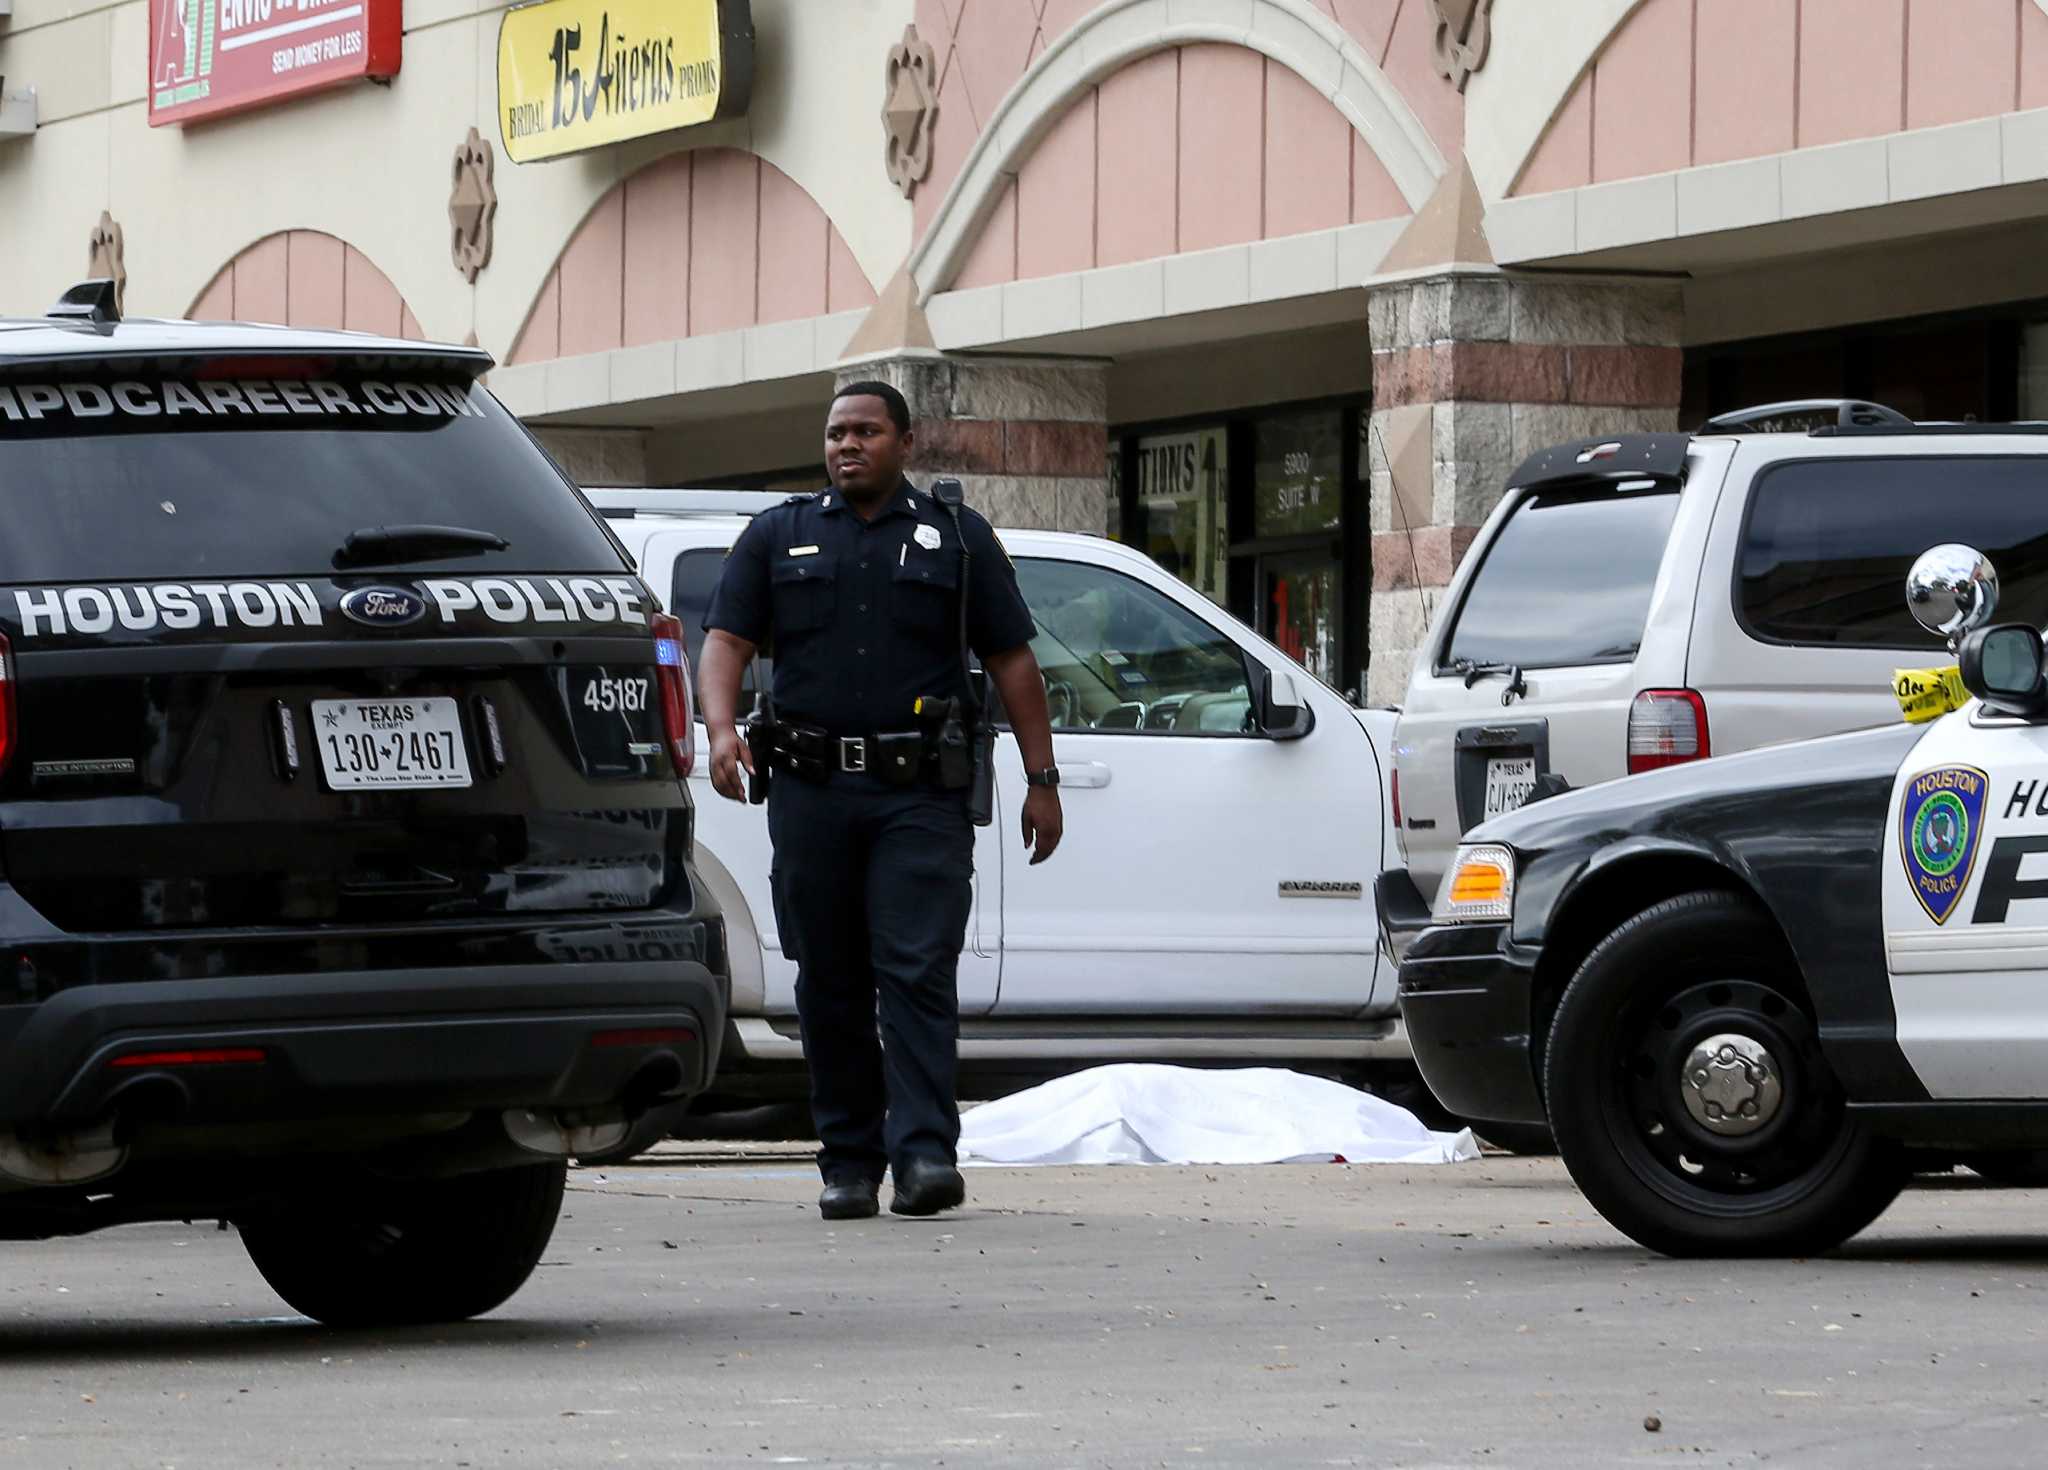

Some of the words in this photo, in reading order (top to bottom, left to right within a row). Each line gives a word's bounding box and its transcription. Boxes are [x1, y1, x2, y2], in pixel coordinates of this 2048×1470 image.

[272, 47, 295, 74] SEND
[294, 39, 322, 67] MONEY
[323, 34, 341, 61] FOR
[341, 29, 362, 57] LESS
[509, 101, 545, 140] BRIDAL
[549, 22, 581, 130] 15
[679, 60, 718, 100] PROMS
[1278, 485, 1305, 511] SUITE
[17, 582, 325, 637] HOUSTON
[364, 591, 410, 616] Ford
[422, 578, 647, 625] POLICE
[584, 677, 649, 712] 45187
[357, 704, 415, 723] TEXAS
[1503, 763, 1525, 776] TEXAS
[1916, 770, 1979, 797] HOUSTON
[1919, 874, 1959, 895] POLICE
